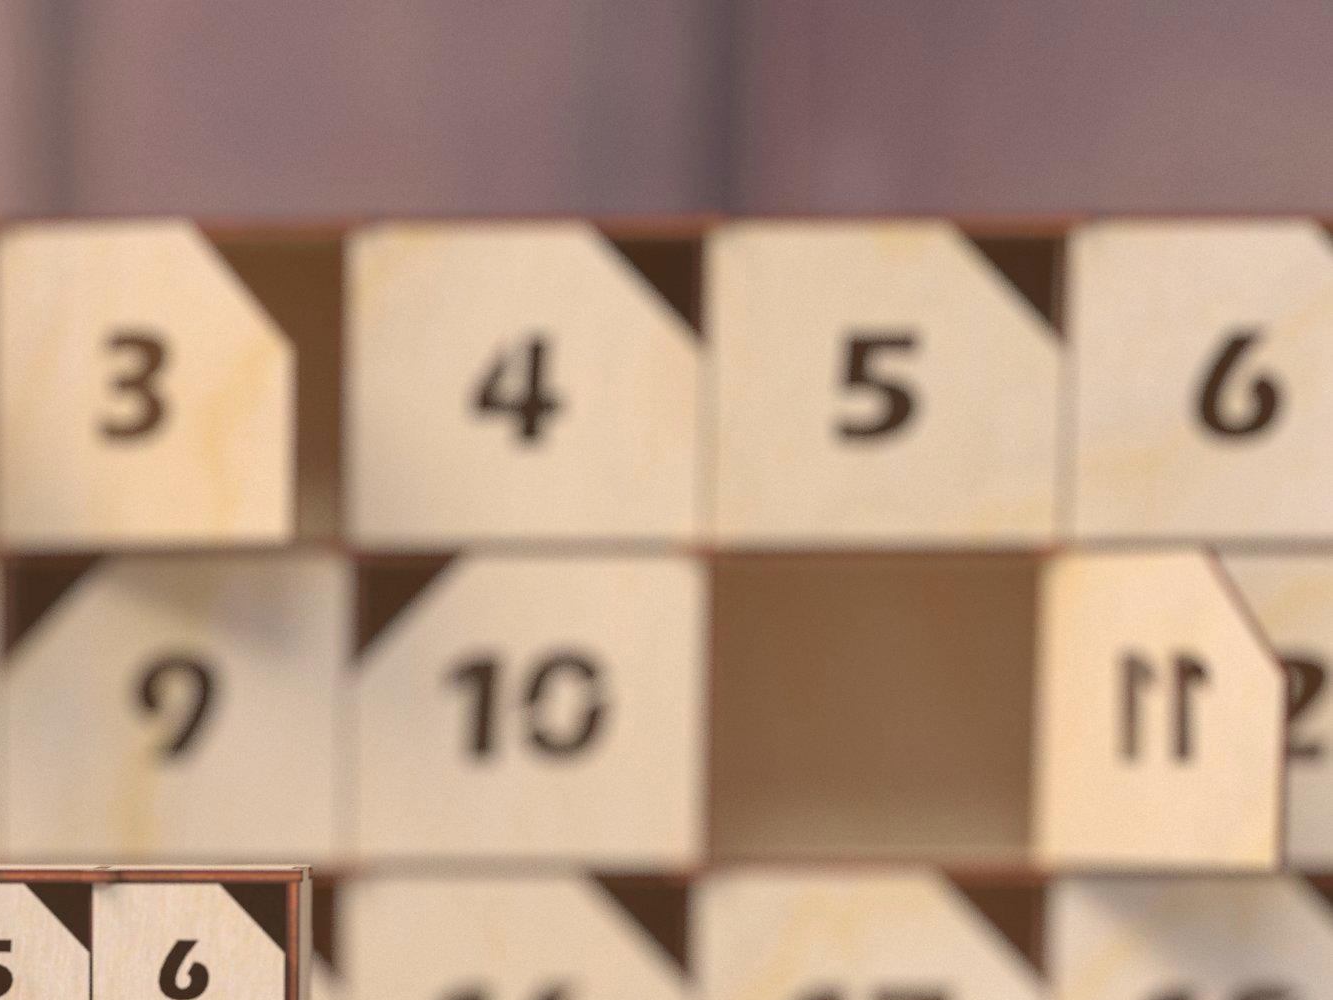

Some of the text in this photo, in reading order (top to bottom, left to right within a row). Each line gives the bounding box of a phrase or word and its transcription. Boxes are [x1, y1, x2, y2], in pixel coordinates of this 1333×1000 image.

[99, 328, 173, 445] 3
[464, 335, 564, 446] 4
[837, 330, 922, 444] 5
[1193, 329, 1287, 443] 6
[126, 651, 223, 762] 9
[441, 650, 611, 761] 10
[1278, 653, 1327, 764] 2
[159, 940, 209, 1000] 6
